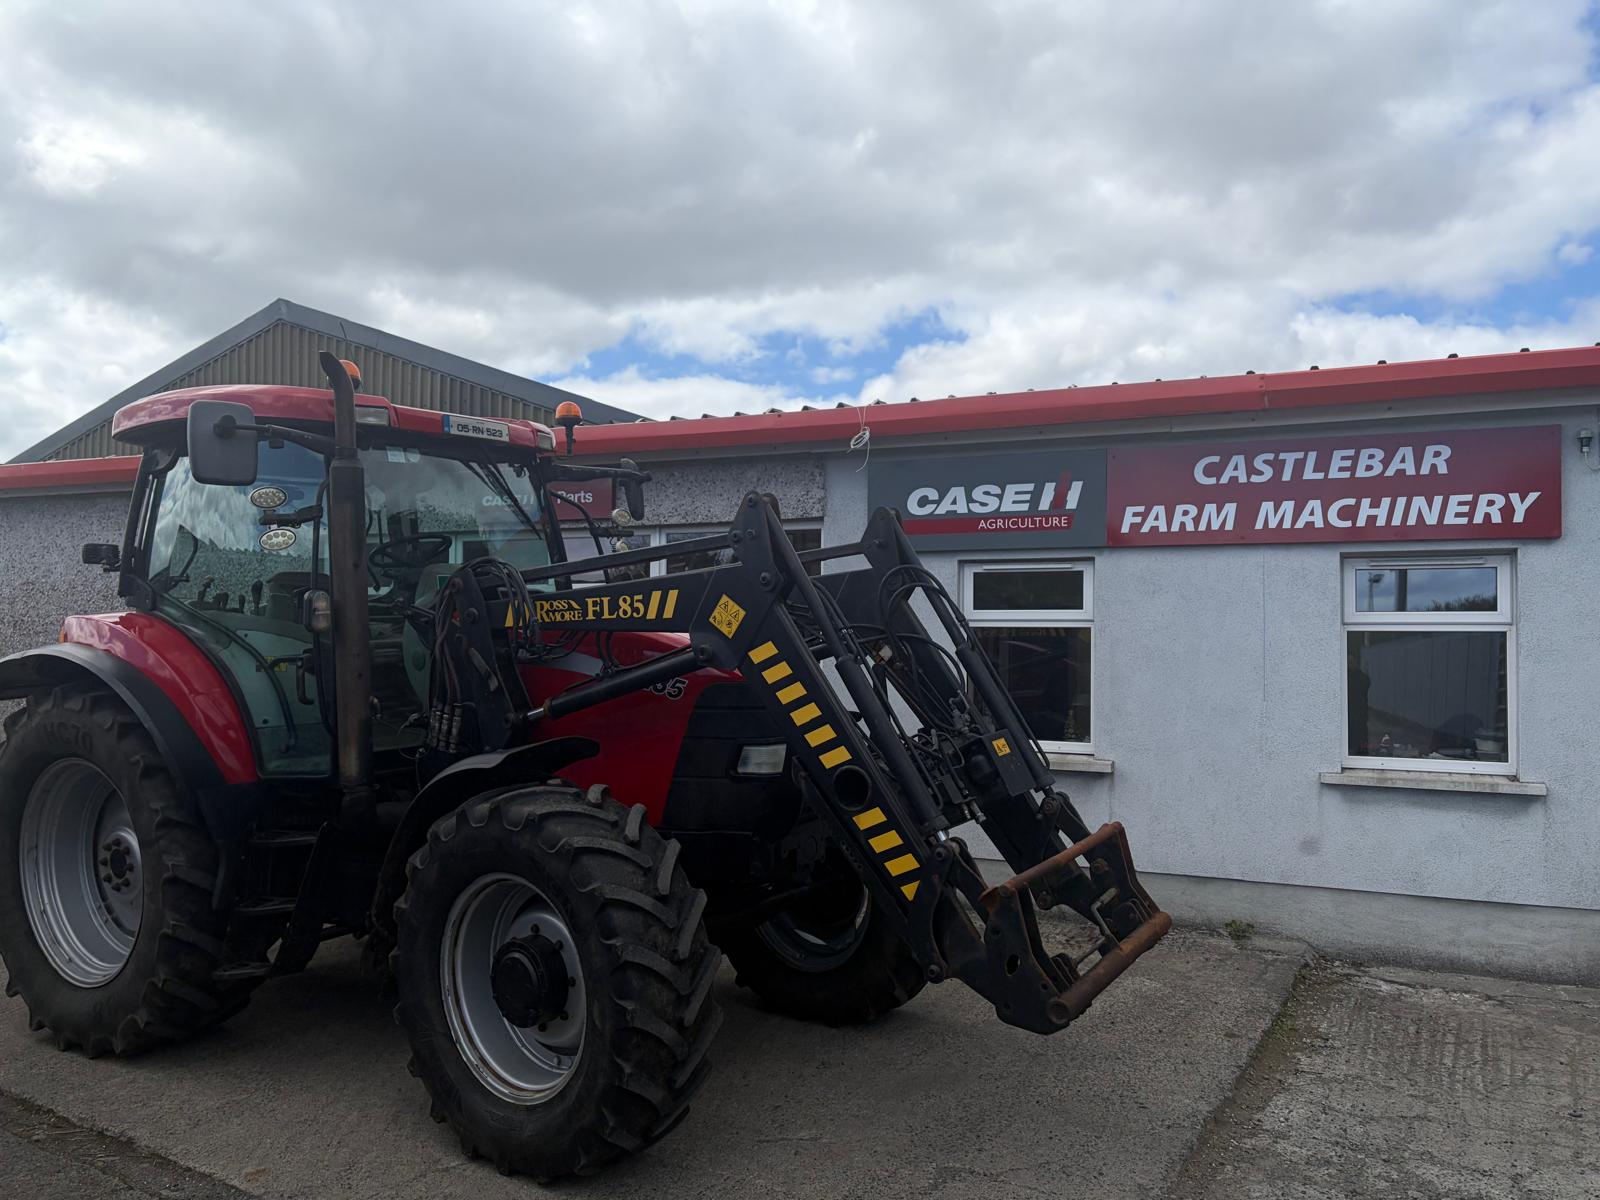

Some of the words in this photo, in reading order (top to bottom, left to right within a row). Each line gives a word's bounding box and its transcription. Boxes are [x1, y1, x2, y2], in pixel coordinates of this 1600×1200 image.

[457, 423, 503, 438] 05-RN-523
[1193, 444, 1452, 485] CASTLEBAR
[906, 483, 1035, 516] CASE
[1120, 502, 1237, 533] FARM
[1254, 491, 1541, 531] MACHINERY
[978, 516, 1068, 530] AGRICULTURE
[585, 594, 645, 621] FL85
